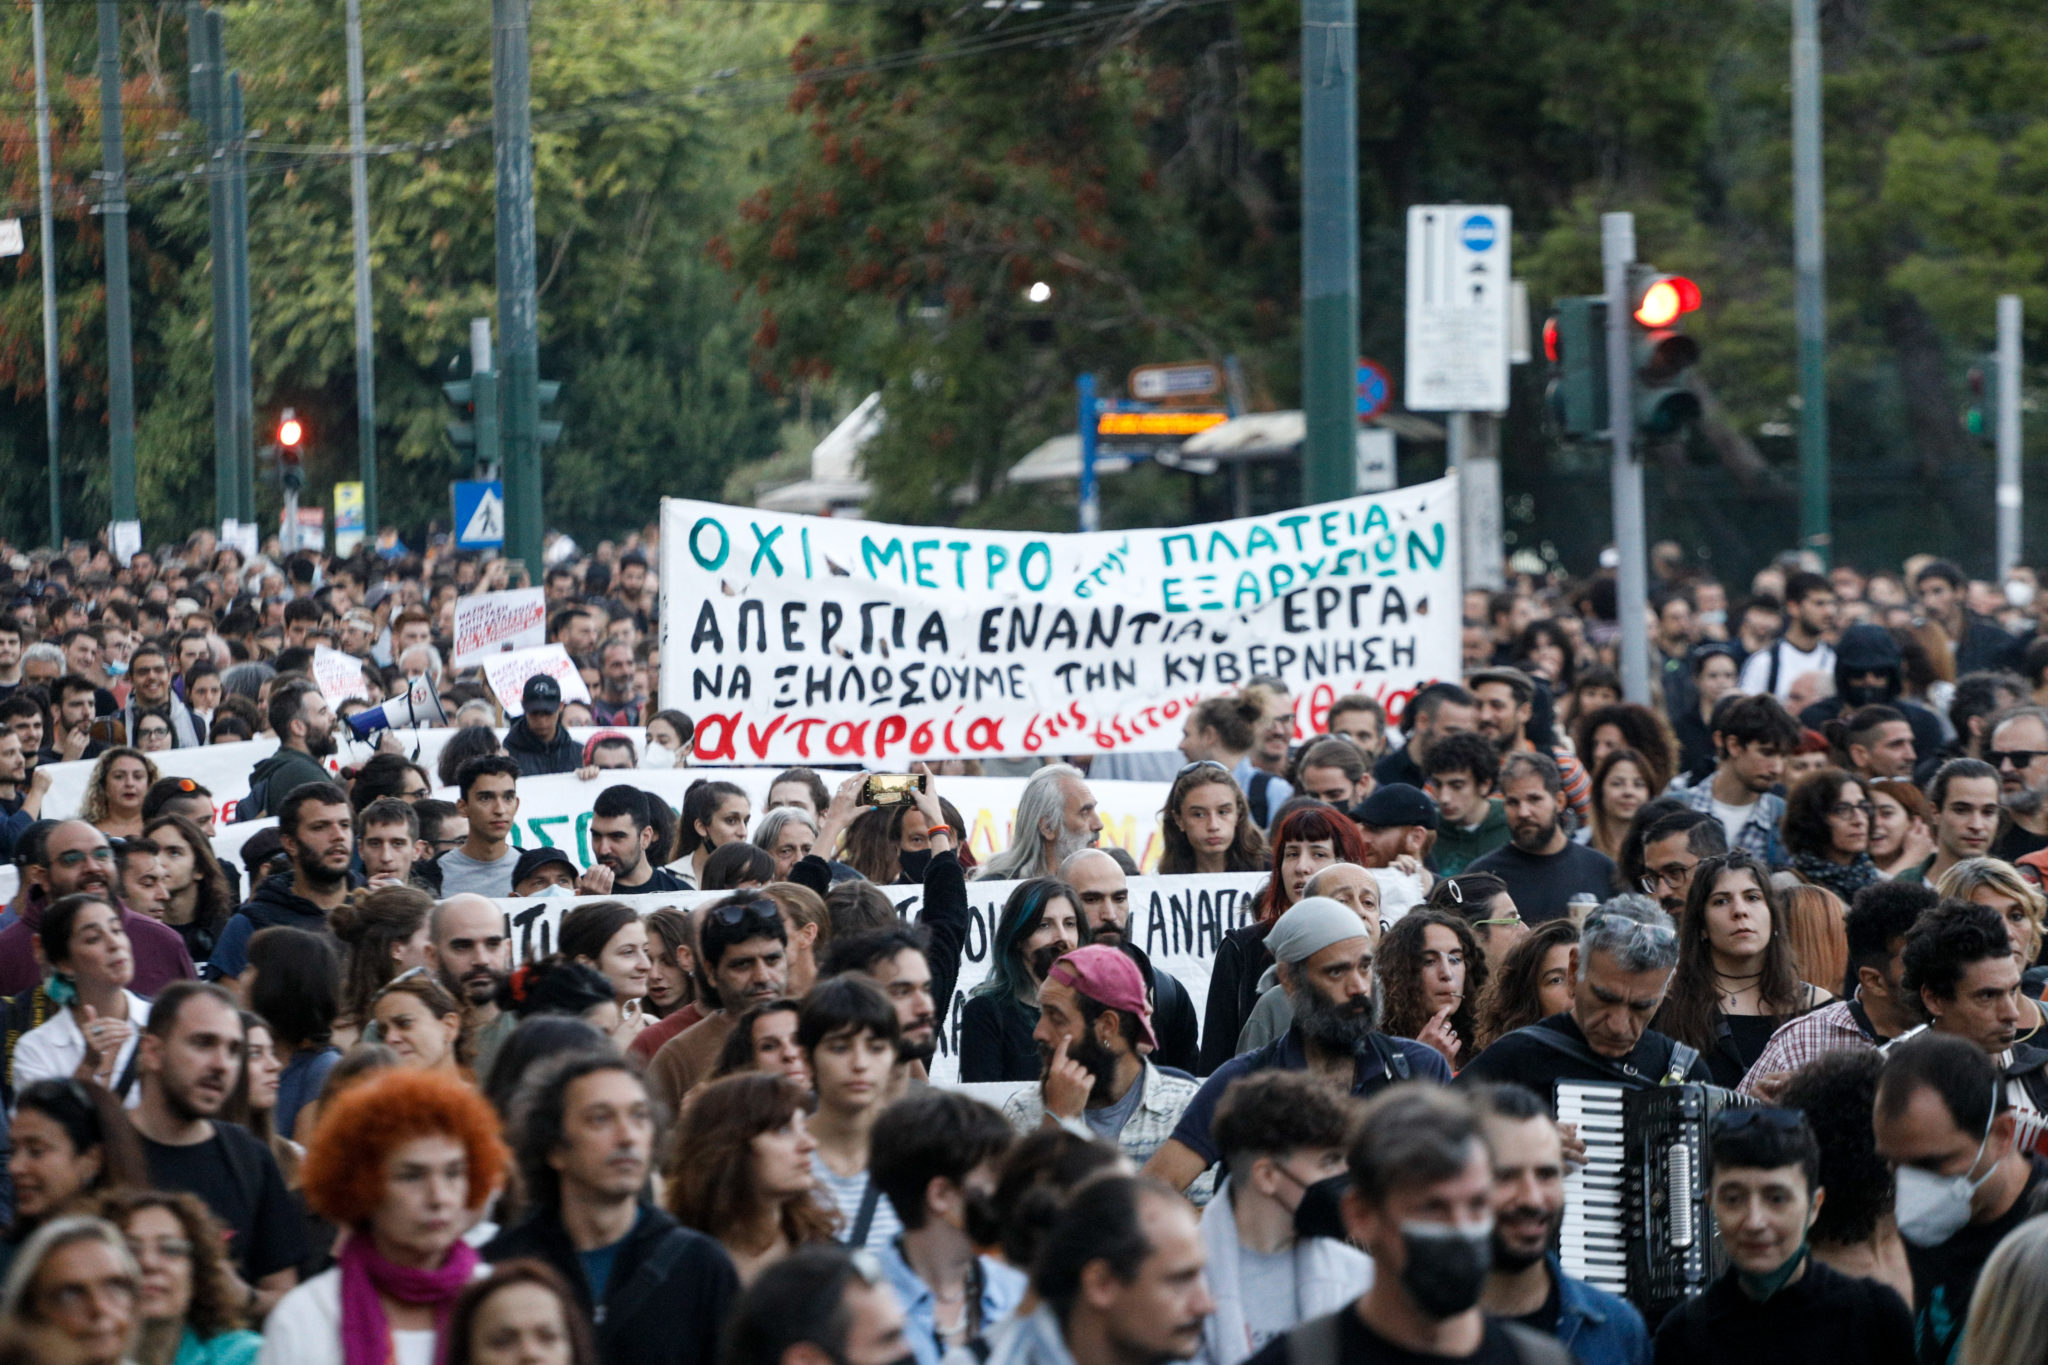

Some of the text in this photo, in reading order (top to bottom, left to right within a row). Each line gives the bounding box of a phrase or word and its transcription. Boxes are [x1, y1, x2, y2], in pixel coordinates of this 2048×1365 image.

[689, 517, 812, 579] ΟΧΙ
[861, 536, 1052, 591] ΜΕΤΡΟ
[1161, 504, 1389, 566] ΠΛΑΤΕΙΑ
[691, 599, 948, 654] ΑΠΕΡΓΙΑ
[978, 603, 1203, 652] ΕΝΑΝΤΙΑ
[1283, 584, 1407, 632] ΕΡΓΑ
[693, 636, 1415, 708] ΝΑ ΞΗΛΩΣΟΥΜΕ ΤΗΝ ΚΥΒΕΡΝΗΣΗ
[693, 705, 1005, 761] ανταρσία
